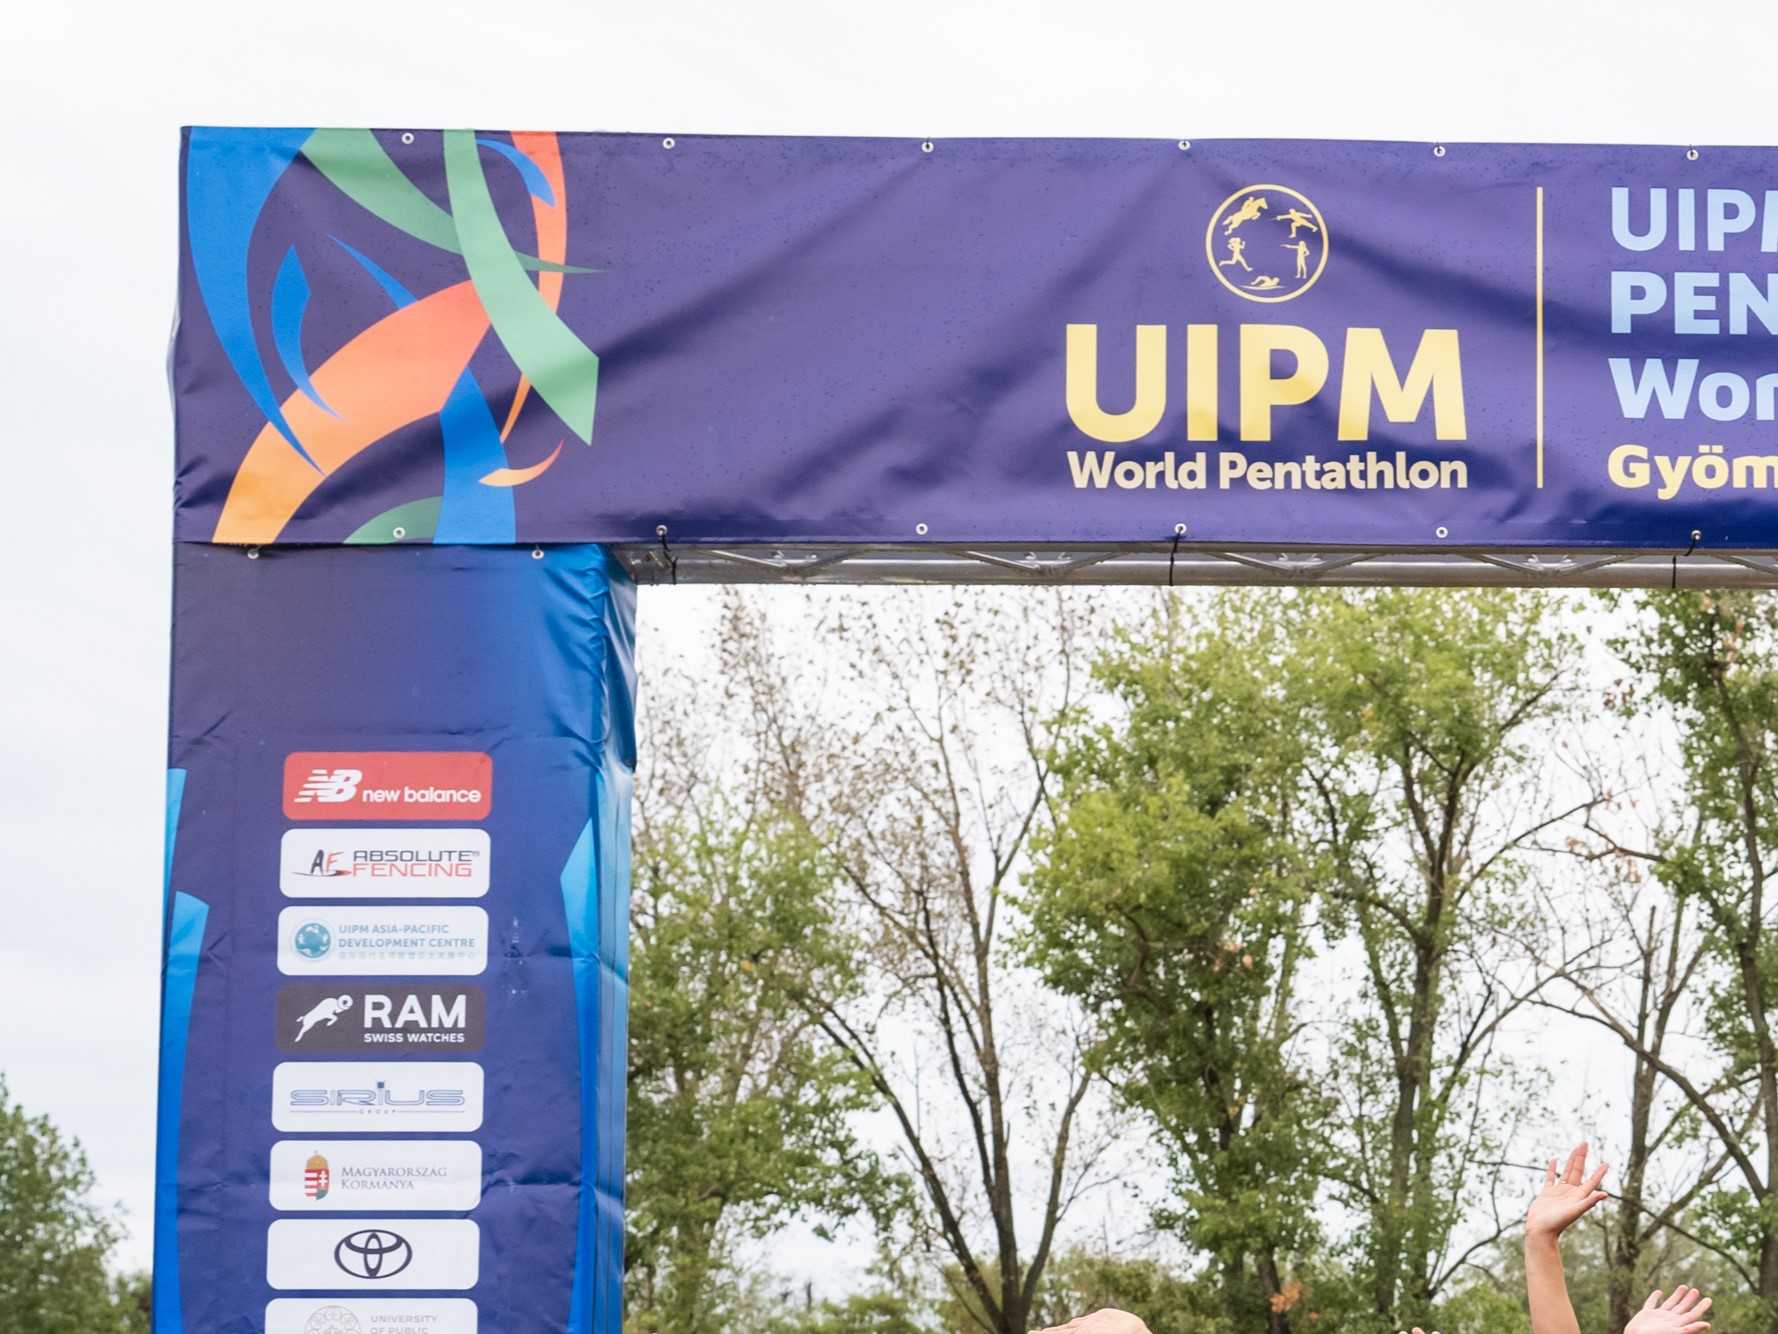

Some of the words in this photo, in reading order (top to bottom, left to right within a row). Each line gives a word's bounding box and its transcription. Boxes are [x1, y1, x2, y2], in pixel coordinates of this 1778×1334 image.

[1066, 324, 1467, 442] UIPM
[1066, 450, 1206, 489] World
[1219, 451, 1468, 490] Pentathlon
[362, 790, 400, 803] new
[404, 787, 482, 803] balance
[352, 863, 473, 877] FENCING
[339, 925, 370, 935] UIPM
[372, 924, 449, 935] ASIA-PACIFIC
[338, 938, 426, 948] DEVELOPMENT
[429, 938, 475, 948] CENTRE
[364, 994, 467, 1028] RAM
[364, 1033, 404, 1043] SWISS
[407, 1033, 465, 1043] WATCHES
[370, 1315, 438, 1324] UNIVERSITY
[370, 1327, 386, 1334] OF
